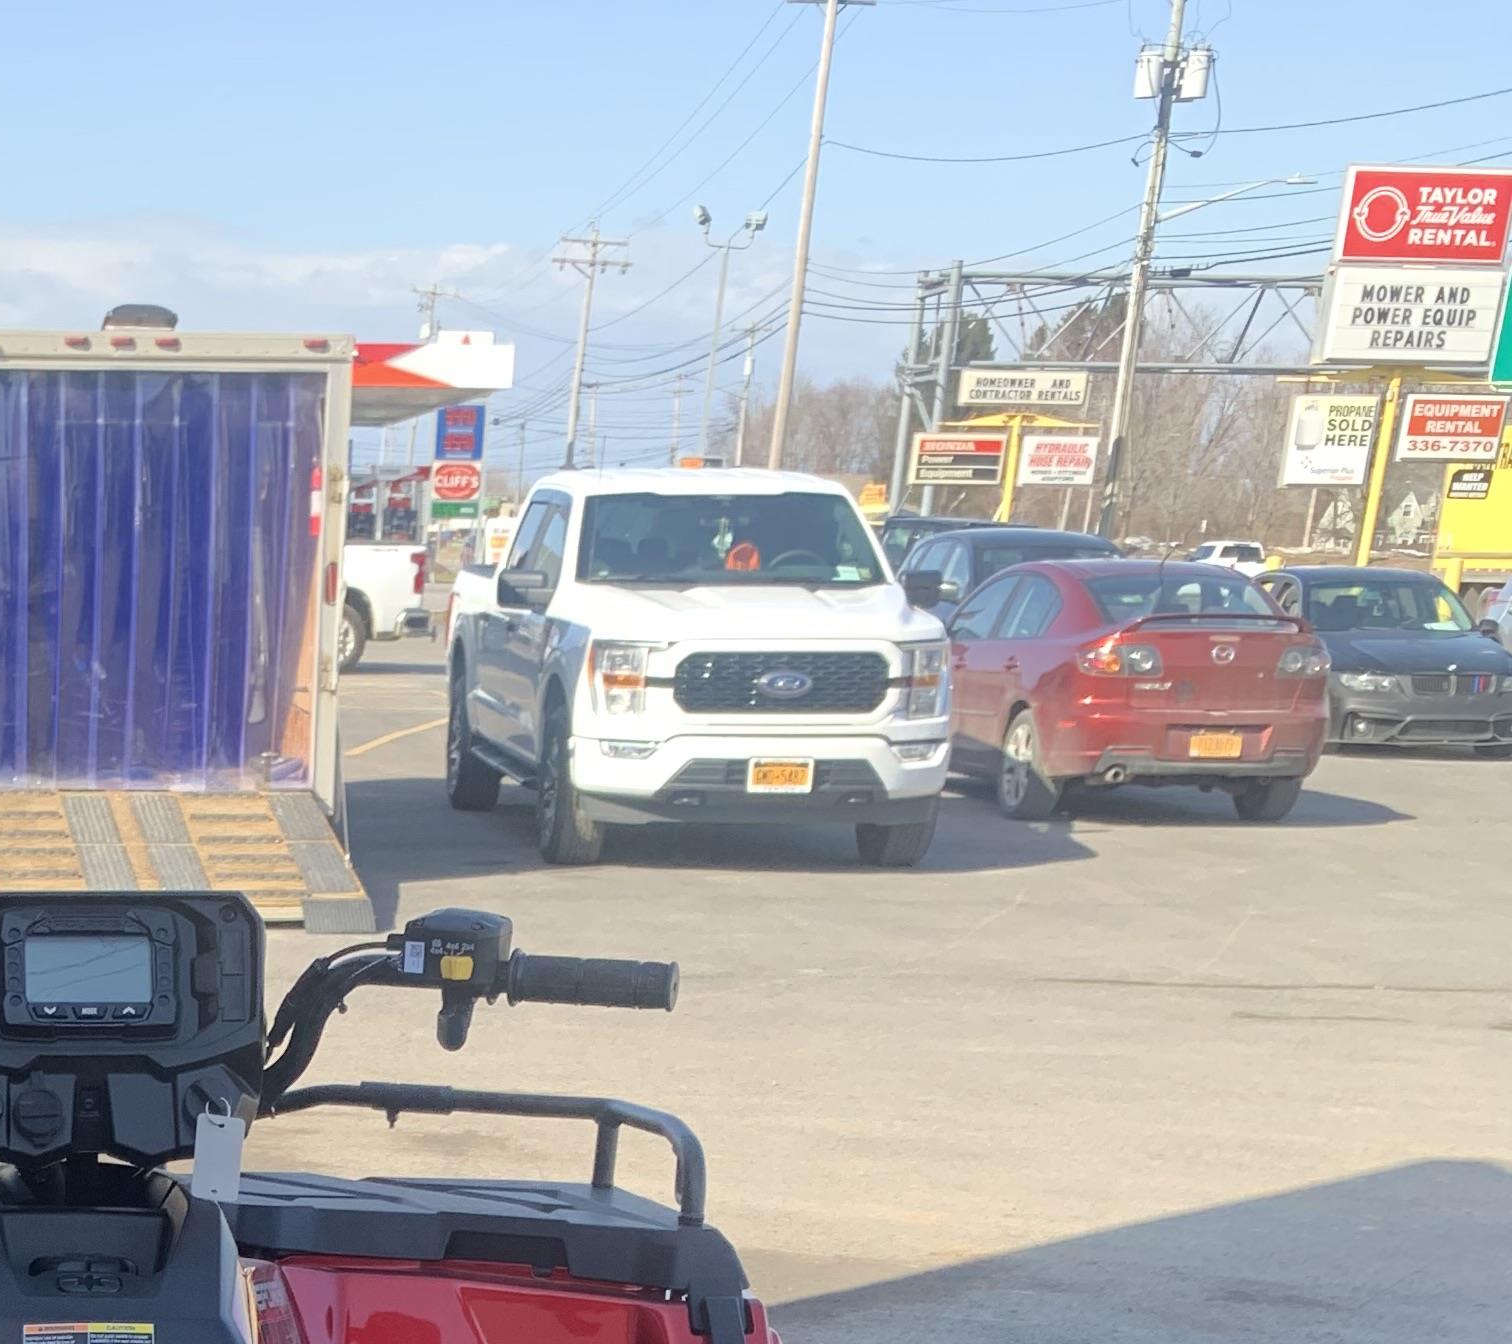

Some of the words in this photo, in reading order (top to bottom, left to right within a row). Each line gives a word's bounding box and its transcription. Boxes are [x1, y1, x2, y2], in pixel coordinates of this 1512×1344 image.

[1418, 187, 1497, 205] TAYLOR
[1408, 229, 1492, 247] RENTAL
[1361, 284, 1425, 303] MOWER
[1435, 287, 1471, 304] AND
[1352, 307, 1412, 325] POWER
[1422, 308, 1476, 327] EQUIP
[1370, 330, 1447, 348] REPAIRS
[976, 378, 1036, 388] HOMEOWNER
[1052, 379, 1071, 388] AND
[969, 389, 1033, 399] CONTRACTOR
[1038, 391, 1081, 401] RENTALS
[1329, 405, 1375, 418] PROPANE
[1414, 404, 1501, 417] EQUIPMENT
[1327, 419, 1372, 432] SOLD
[1425, 420, 1482, 433] RENTAL
[1325, 434, 1368, 446] HERE
[1408, 440, 1494, 452] 336-7370
[1035, 443, 1089, 454] HYDRAULIC
[921, 455, 954, 464] Power
[1029, 455, 1055, 467] HOSE
[1057, 456, 1093, 469] REPAIR
[919, 469, 973, 479] Equipment
[435, 476, 479, 488] CLIFF'S
